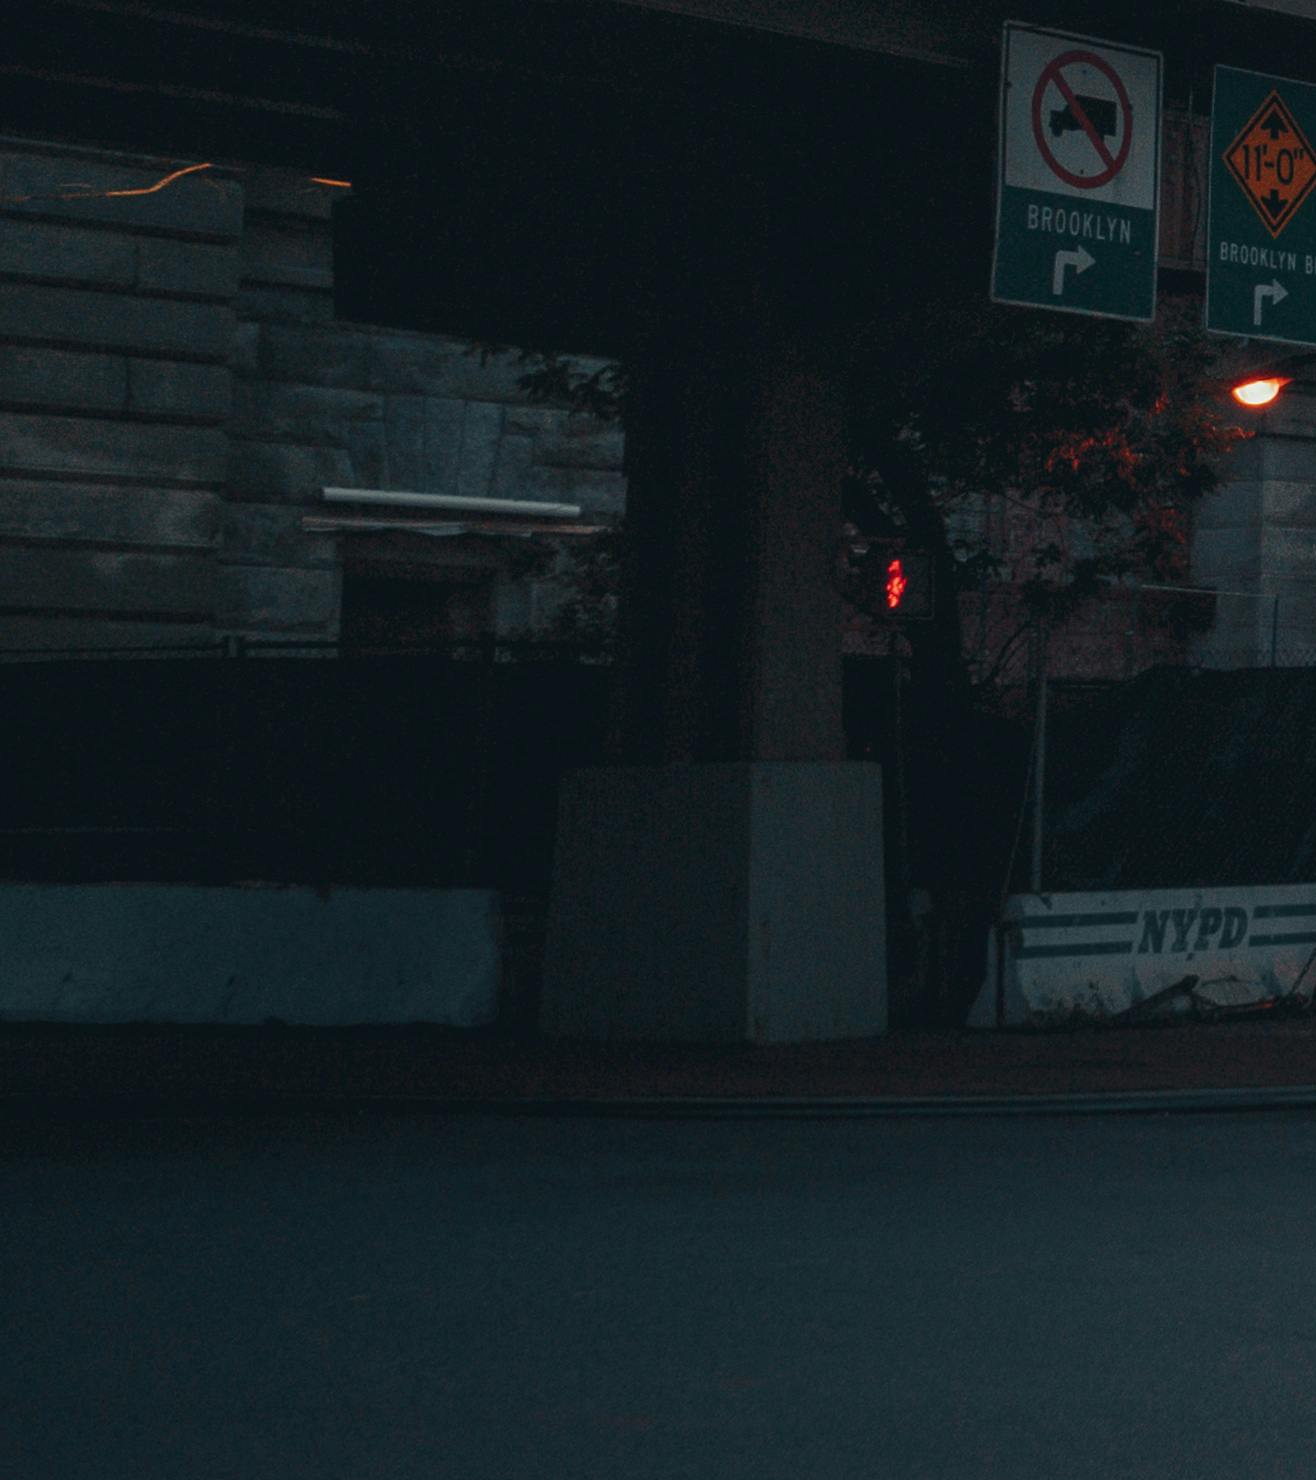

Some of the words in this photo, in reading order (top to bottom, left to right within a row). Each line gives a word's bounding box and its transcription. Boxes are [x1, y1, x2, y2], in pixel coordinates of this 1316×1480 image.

[1027, 203, 1132, 244] BROOKLYN
[1220, 241, 1297, 271] BROOKLYN
[1138, 906, 1249, 954] NYPD
